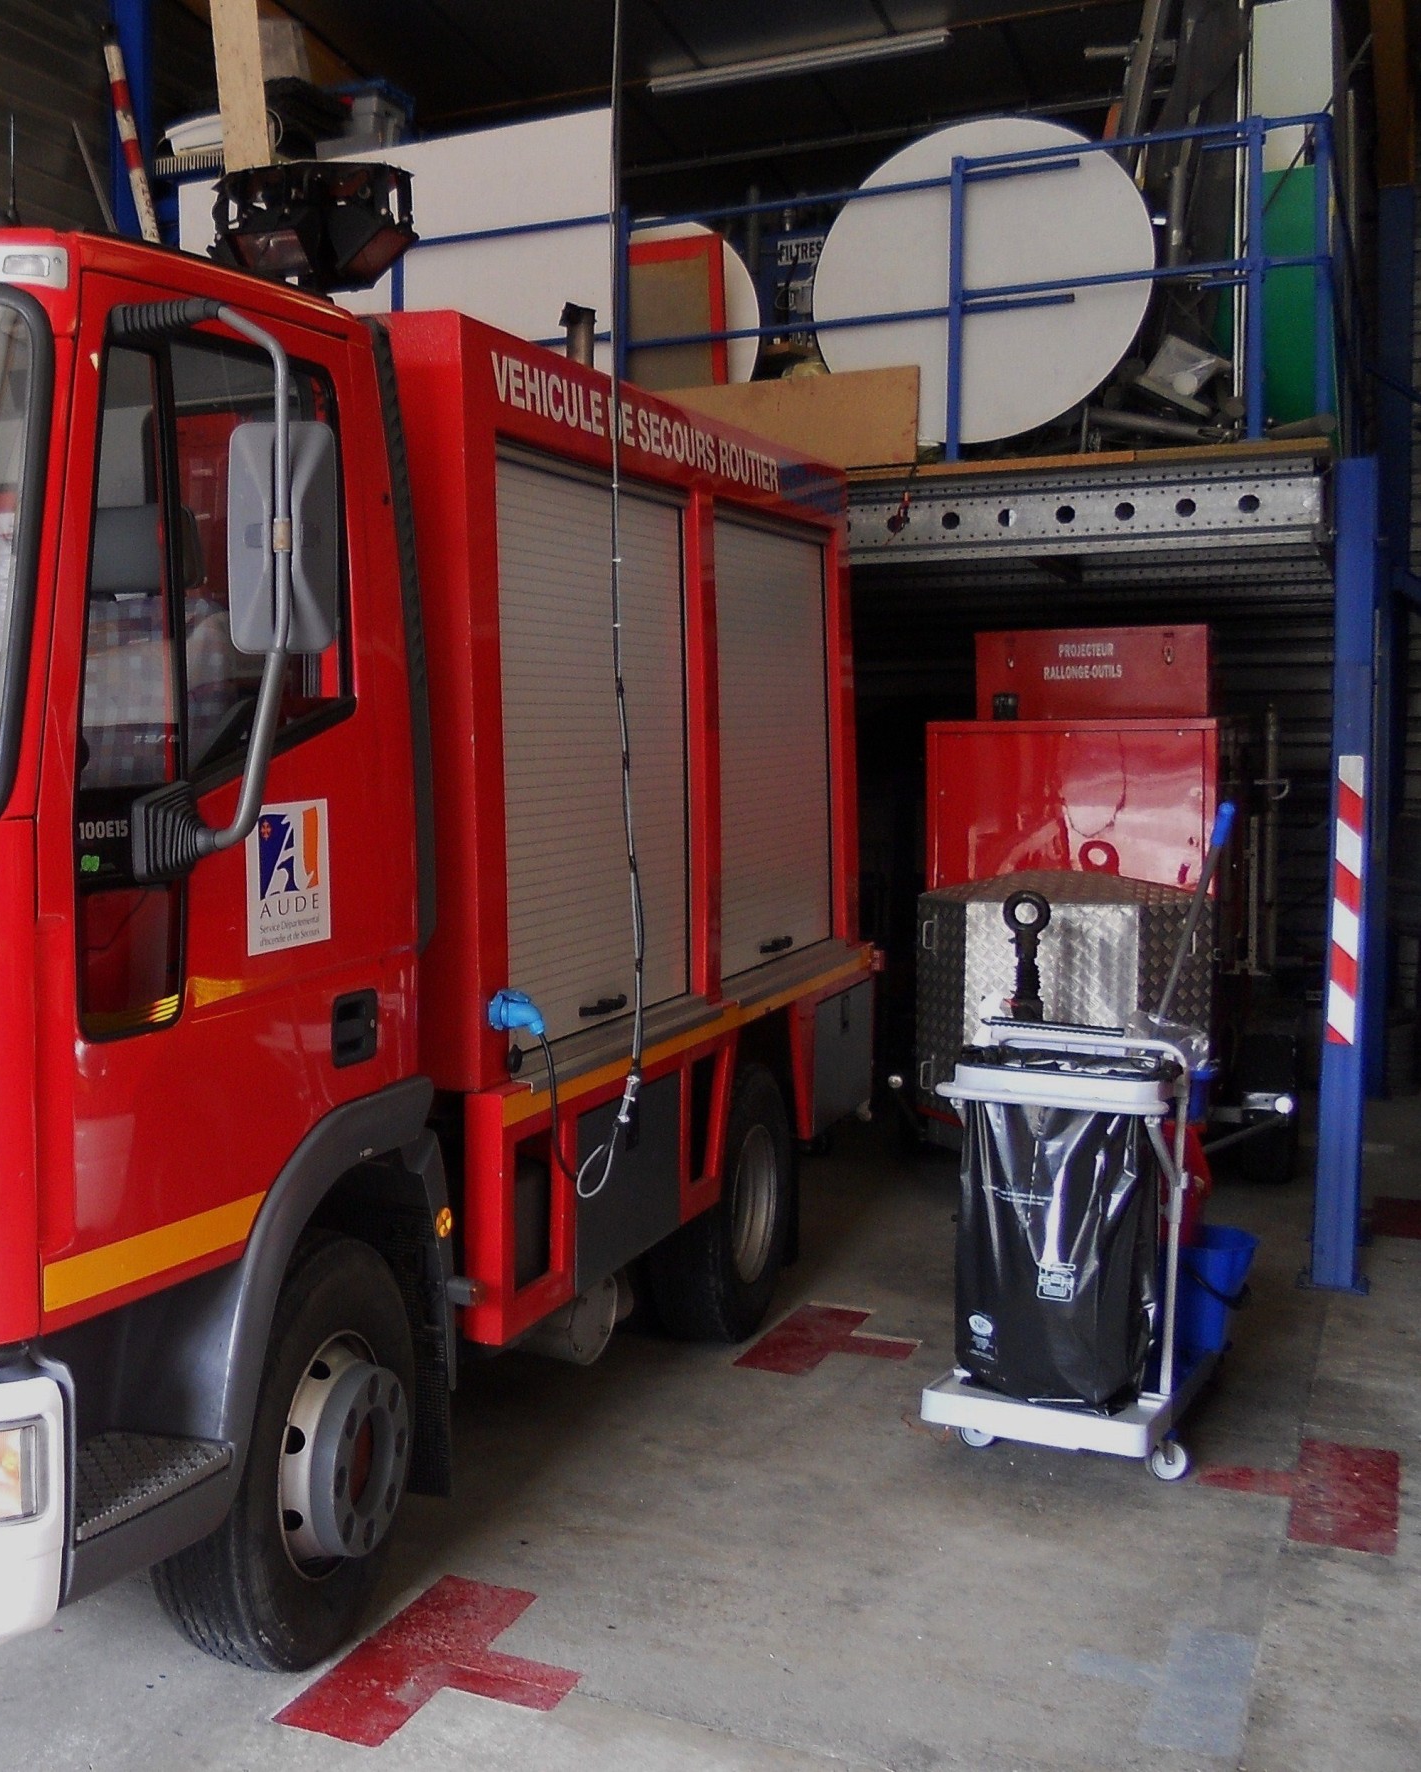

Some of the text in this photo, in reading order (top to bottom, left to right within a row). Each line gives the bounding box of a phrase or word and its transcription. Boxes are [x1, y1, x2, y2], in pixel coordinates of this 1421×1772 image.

[491, 351, 778, 493] VEHICULE DE SECOURS ROUTIER
[1058, 642, 1114, 658] PROJECTEUR
[1043, 664, 1122, 681] RALLONGE-OUTILS
[79, 819, 128, 840] 100E15
[260, 893, 319, 920] AUDE
